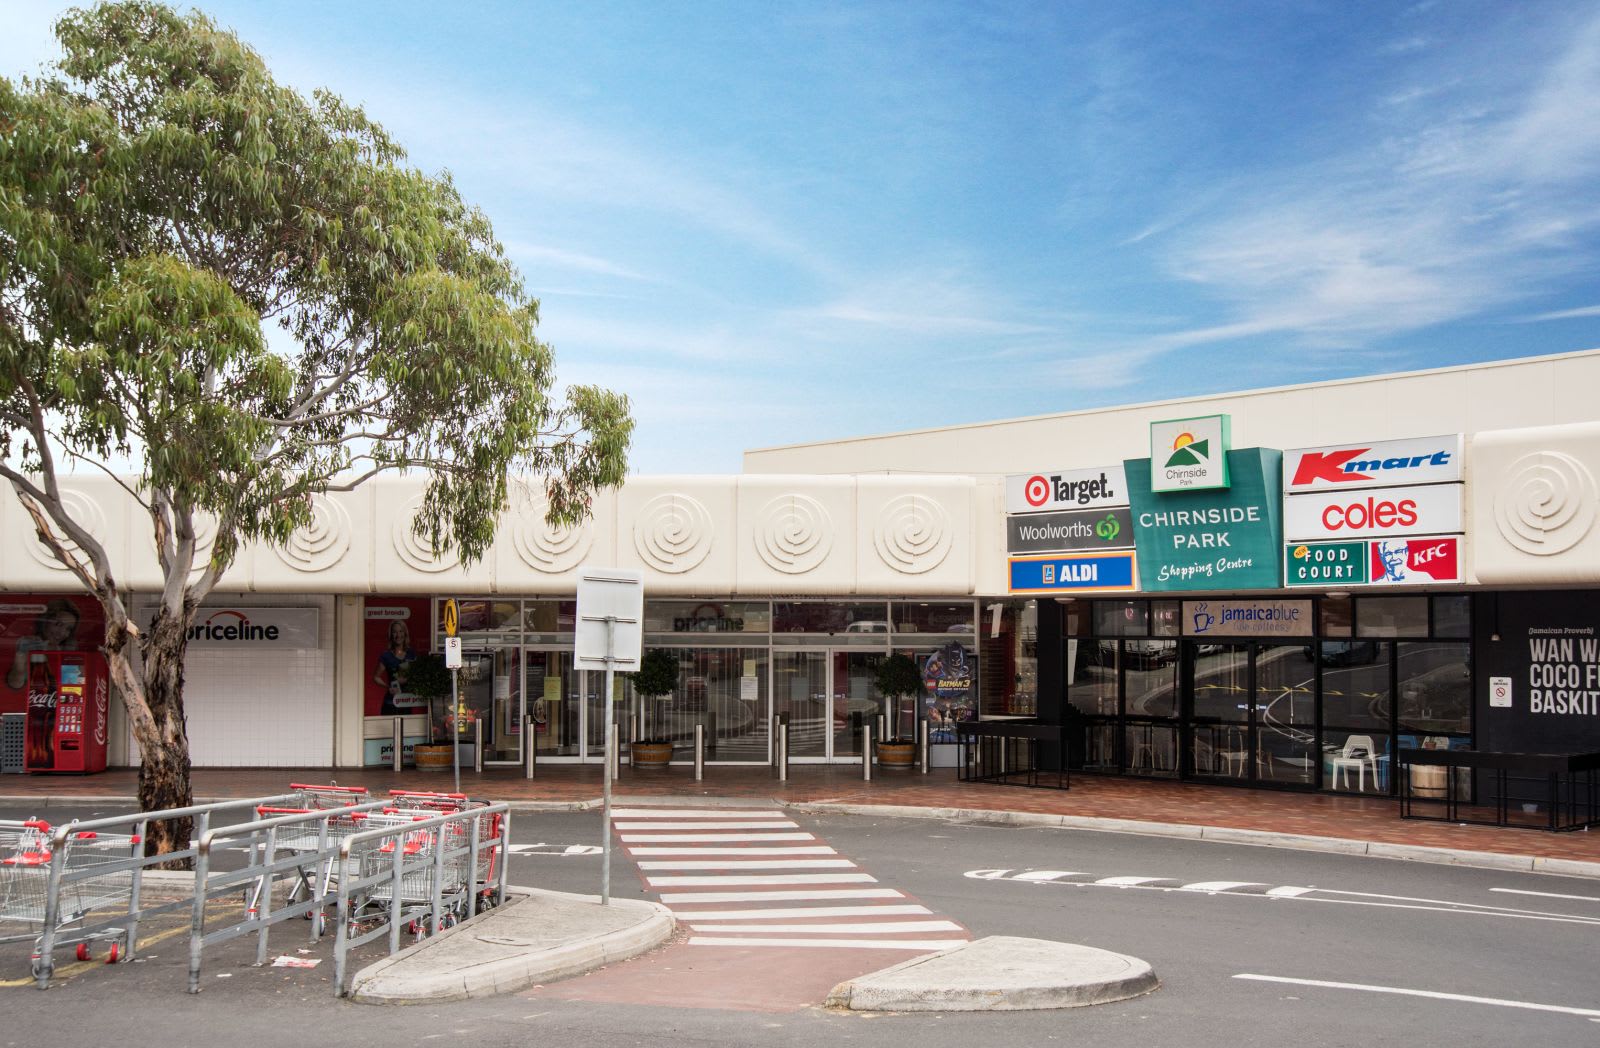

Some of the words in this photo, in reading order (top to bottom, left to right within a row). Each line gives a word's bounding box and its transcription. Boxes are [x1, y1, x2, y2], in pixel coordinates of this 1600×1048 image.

[1166, 468, 1207, 480] Chirnside
[1292, 448, 1451, 485] Kmart
[1140, 506, 1260, 527] CHIRNSIDE
[1322, 497, 1417, 530] coles
[1020, 521, 1092, 540] Woolworths
[1174, 532, 1231, 548] PARK
[1304, 549, 1348, 562] FOOD
[1414, 543, 1447, 566] KFC
[1060, 564, 1097, 582] ALDI
[1158, 562, 1213, 581] Shopping
[1217, 557, 1252, 572] Centre
[1299, 566, 1354, 578] COURT
[1220, 604, 1299, 624] jamaicablue
[1529, 639, 1573, 662] WAN
[1579, 639, 1600, 662] W
[1530, 664, 1580, 688] COCO
[1586, 664, 1600, 688] F
[1530, 689, 1600, 715] BASKIT
